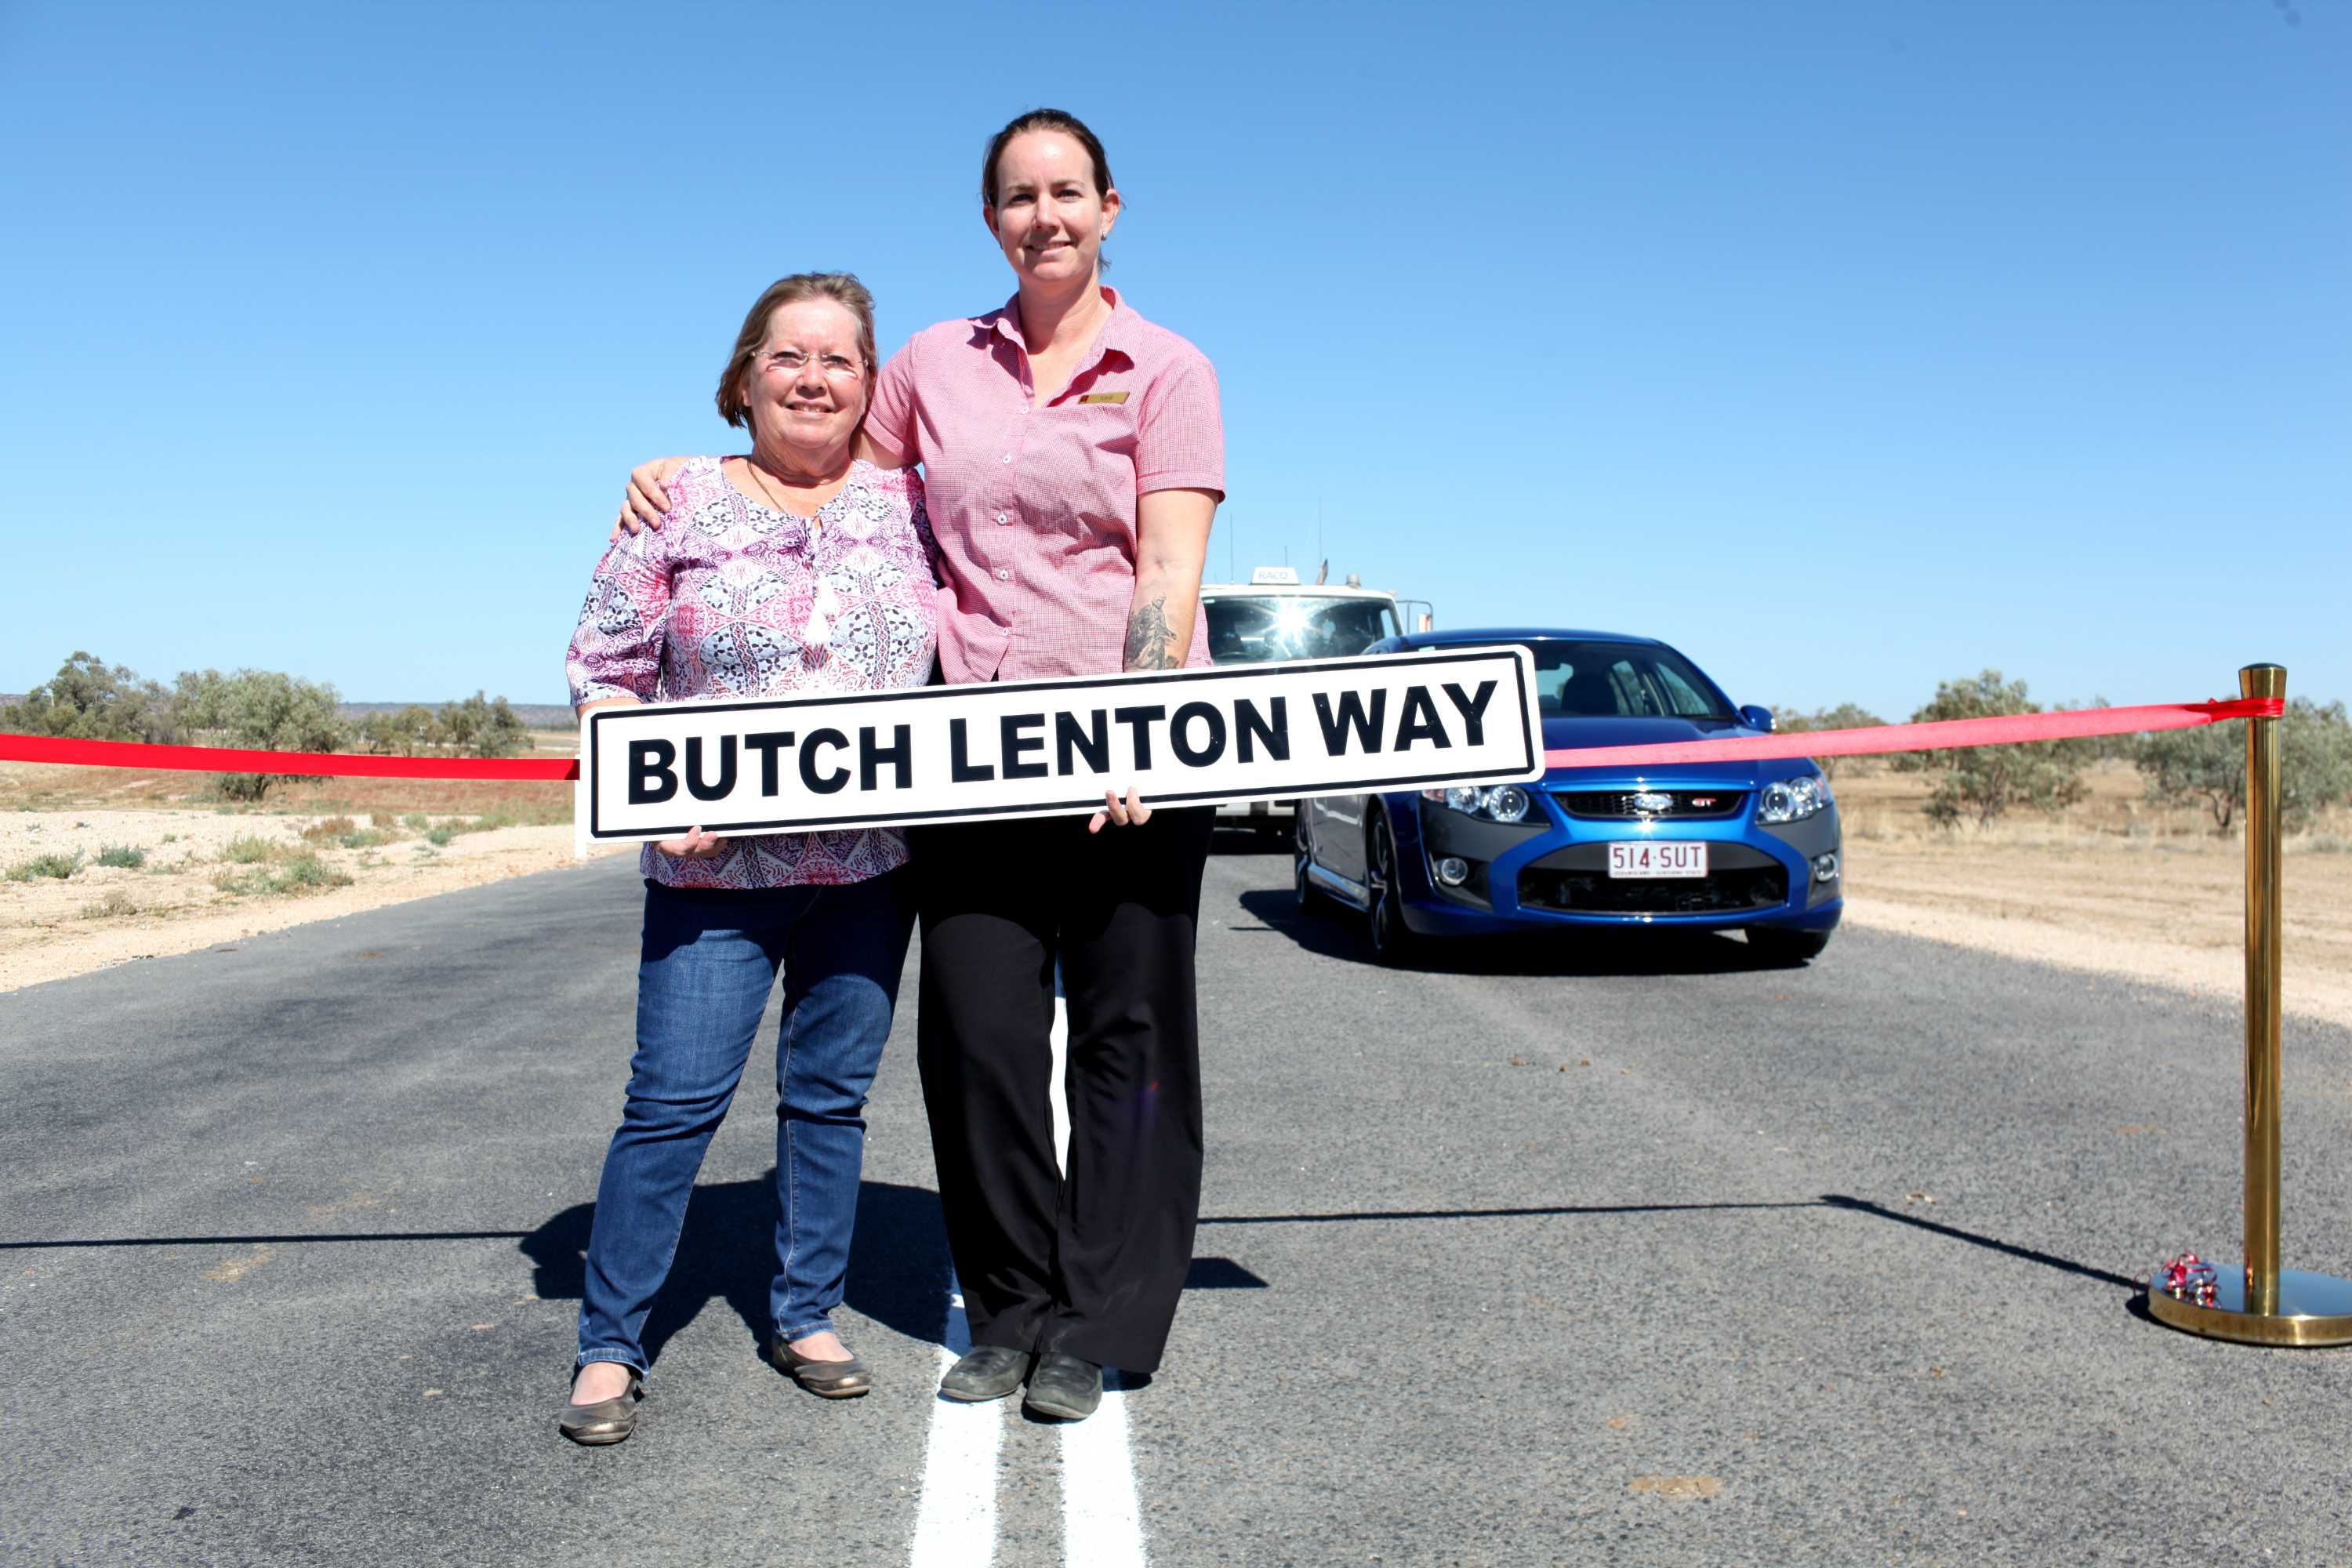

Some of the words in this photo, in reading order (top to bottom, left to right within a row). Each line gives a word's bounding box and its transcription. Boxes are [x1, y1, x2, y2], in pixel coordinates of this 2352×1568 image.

[628, 724, 913, 805] BUTCH
[949, 696, 1290, 783] LENTON
[1312, 680, 1498, 757] WAY
